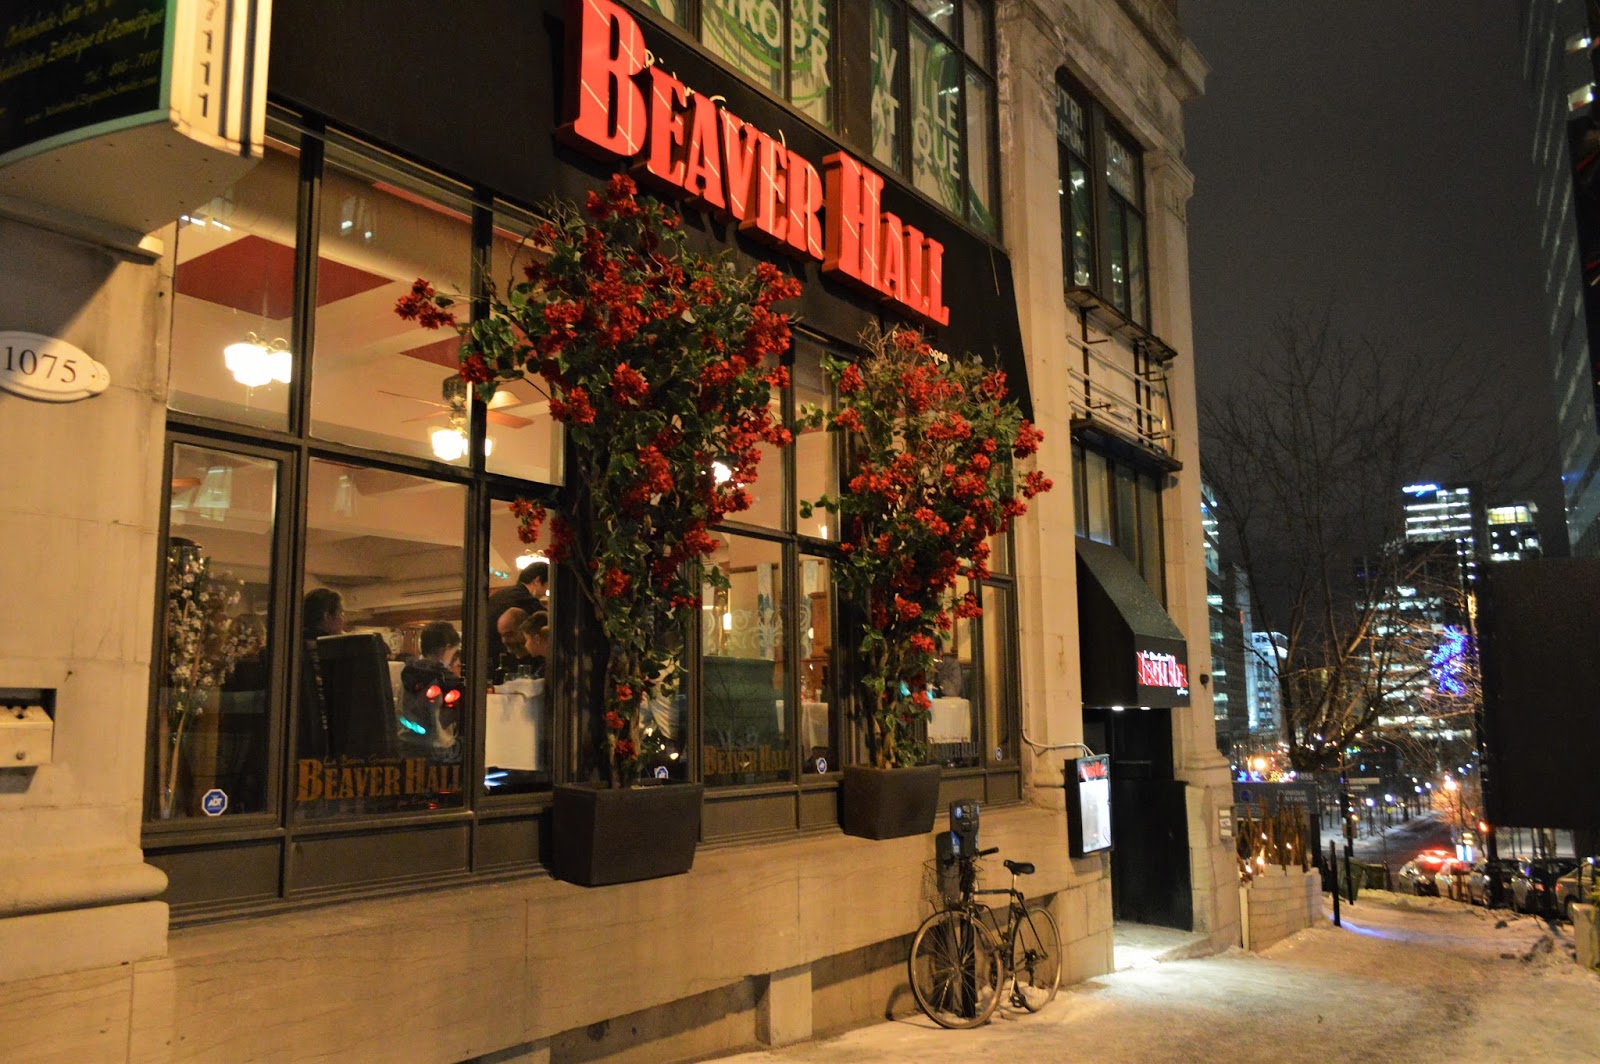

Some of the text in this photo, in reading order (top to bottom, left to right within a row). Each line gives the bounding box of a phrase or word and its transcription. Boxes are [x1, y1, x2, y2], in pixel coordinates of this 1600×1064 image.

[572, 0, 825, 261] BEAVER
[832, 151, 949, 327] HALL
[5, 346, 77, 384] 1075
[296, 757, 463, 803] BEAVER HALL
